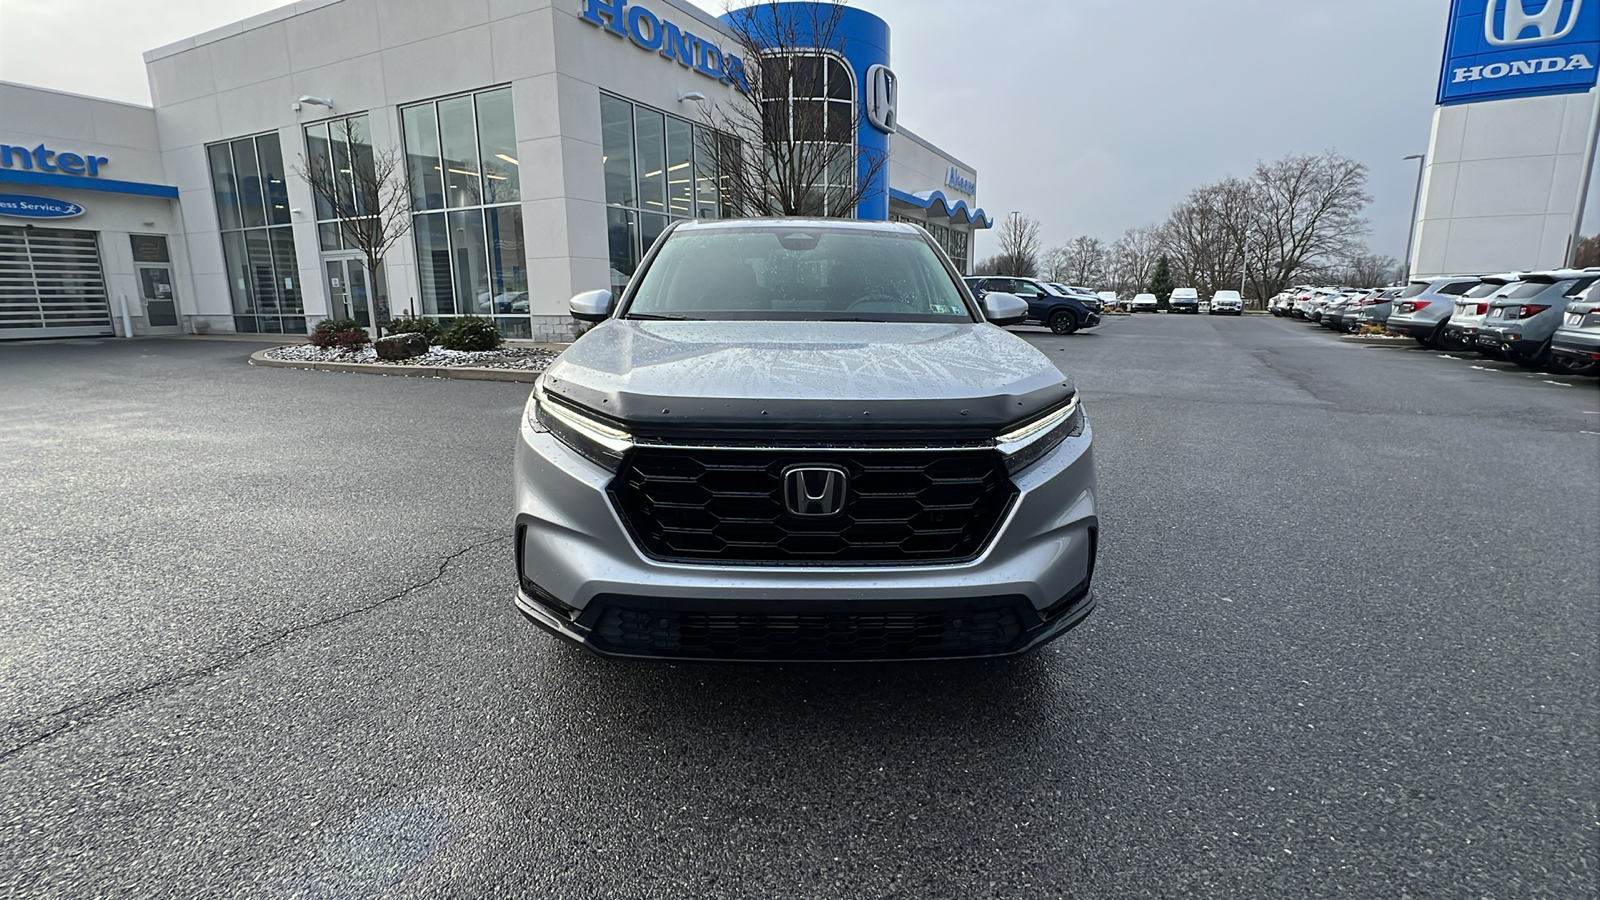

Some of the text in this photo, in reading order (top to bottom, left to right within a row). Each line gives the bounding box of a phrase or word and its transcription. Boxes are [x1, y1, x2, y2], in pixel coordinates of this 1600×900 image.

[578, 0, 750, 94] HONDA
[1451, 54, 1594, 83] HONDA
[0, 143, 109, 176] nter
[20, 201, 61, 212] Service
